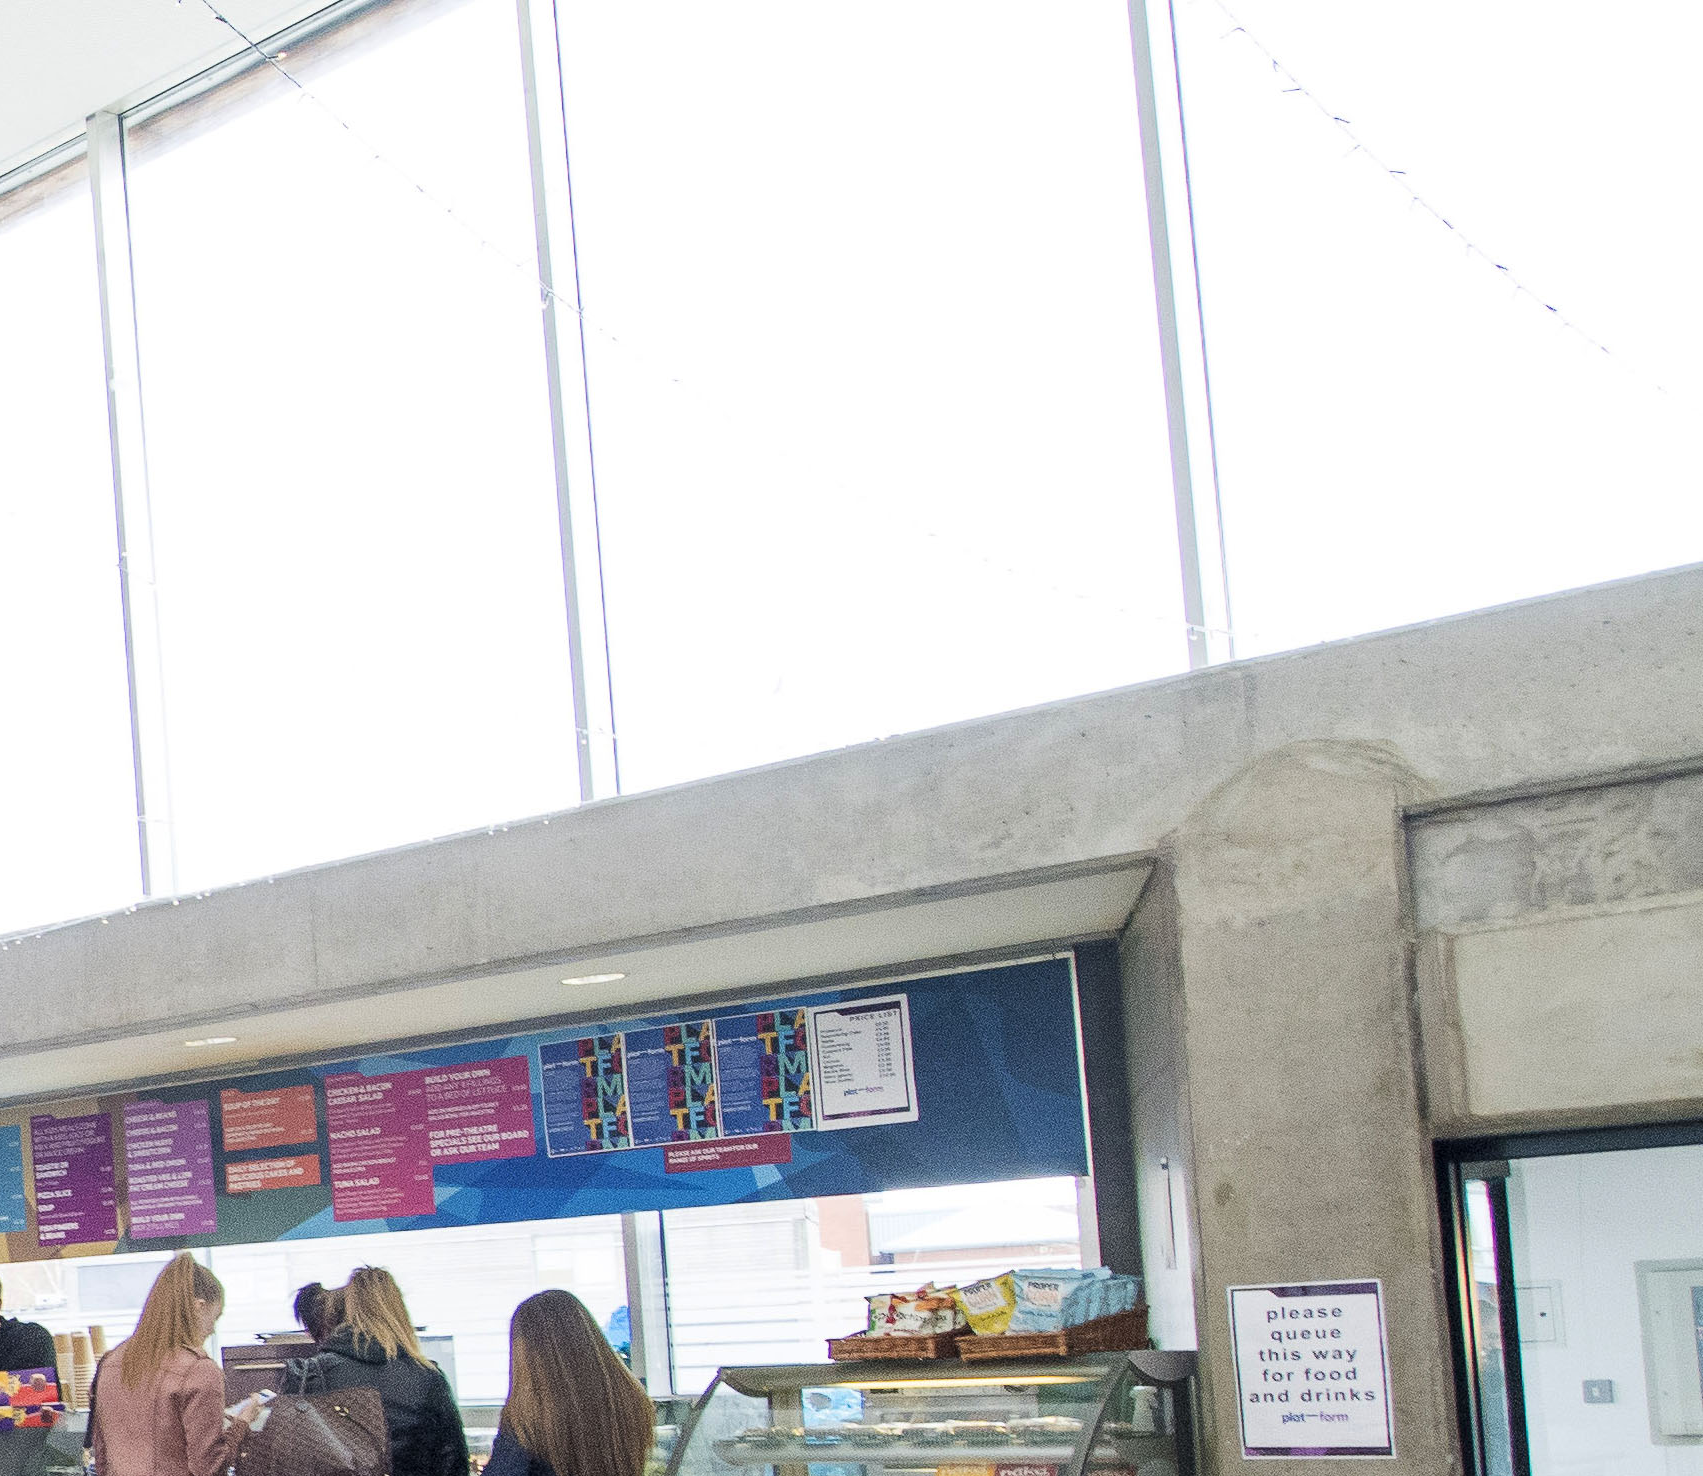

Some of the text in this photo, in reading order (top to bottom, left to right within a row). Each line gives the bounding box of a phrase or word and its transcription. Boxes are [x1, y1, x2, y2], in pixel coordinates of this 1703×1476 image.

[849, 1010, 897, 1022] PRICE LIST
[425, 1069, 490, 1084] BUILD YOUR OWN
[327, 1085, 358, 1096] CHICKEN
[357, 1091, 383, 1102] SALAD
[356, 1126, 380, 1137] SALAD
[429, 1124, 497, 1139] FOR PRE-THEATRE
[429, 1129, 528, 1148] SPECIALS SEE OUR BOARD
[430, 1142, 499, 1156] OR ASK OUR TEAM
[334, 1176, 379, 1189] TUNA SALAD
[1027, 1281, 1060, 1291] PROPER
[1267, 1307, 1343, 1323] please
[1271, 1328, 1341, 1343] queue
[1259, 1348, 1357, 1363] this way
[1262, 1367, 1357, 1382] for food
[1249, 1388, 1376, 1403] and drinks
